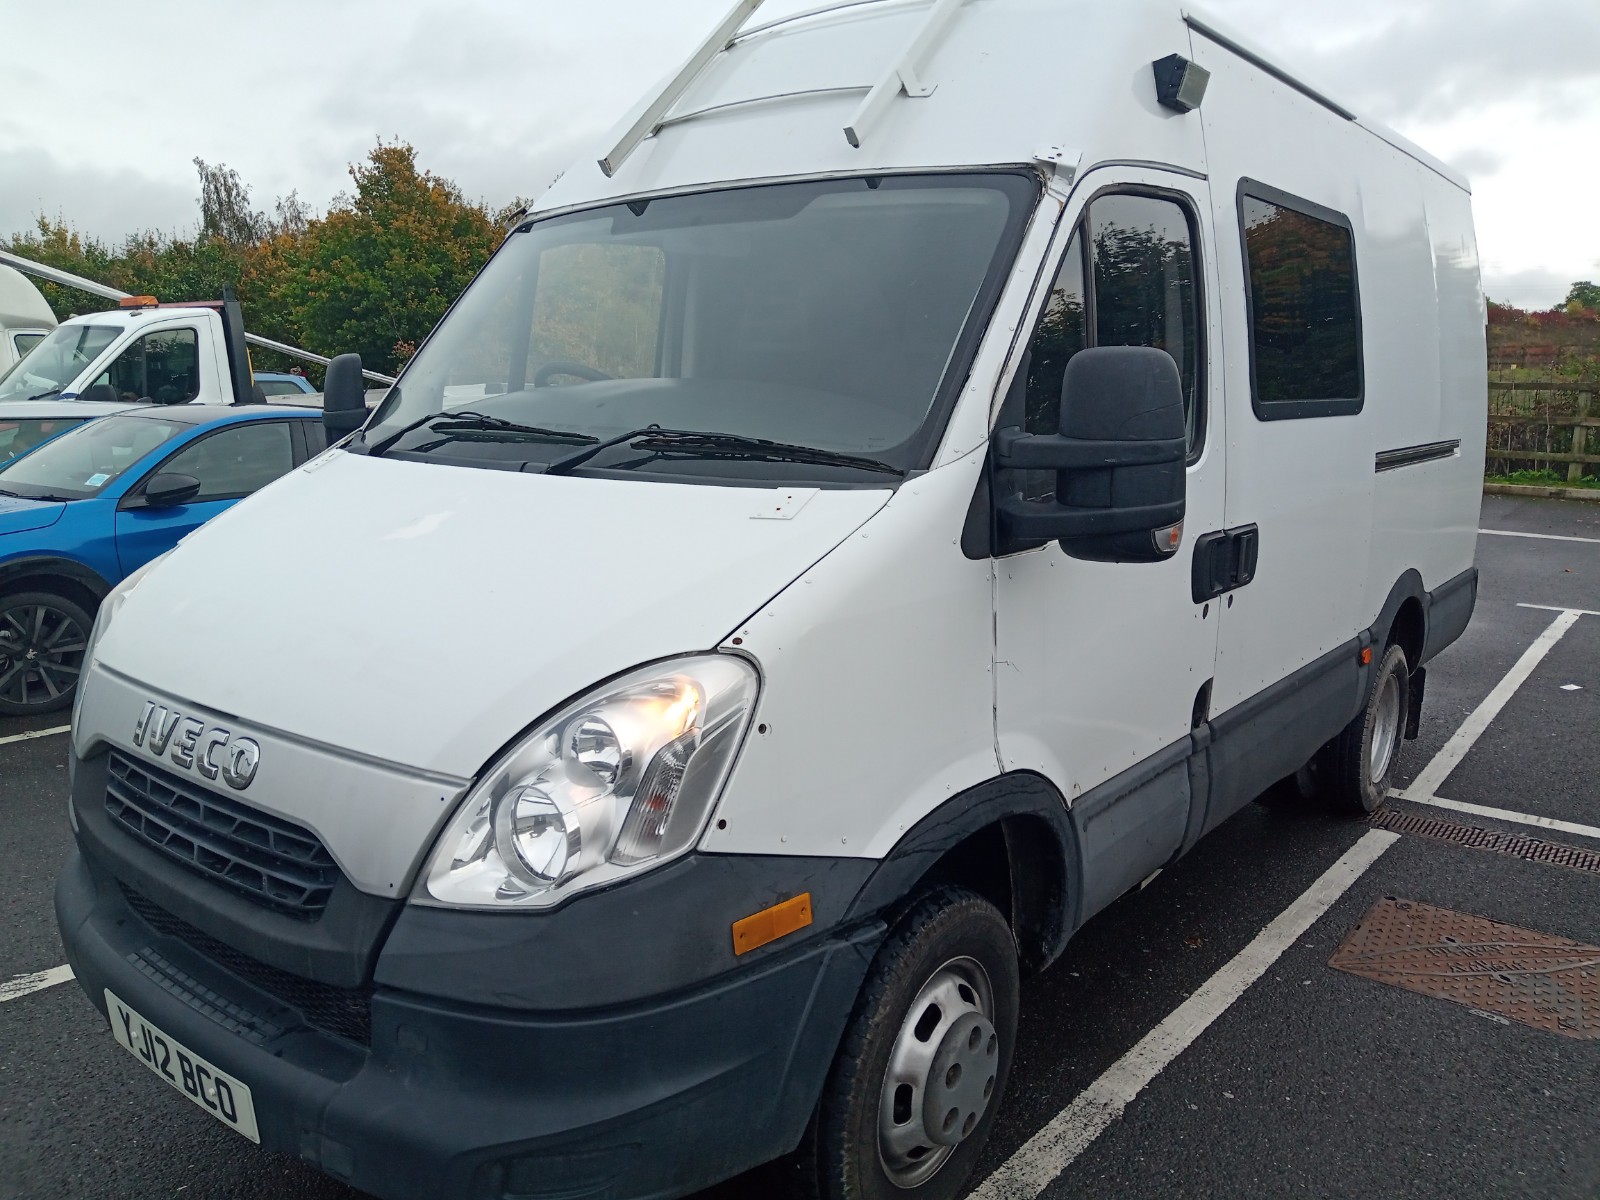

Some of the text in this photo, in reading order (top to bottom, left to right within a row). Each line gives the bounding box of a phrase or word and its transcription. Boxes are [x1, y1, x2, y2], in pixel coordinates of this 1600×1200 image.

[133, 701, 260, 790] IVECO
[117, 1004, 238, 1125] YJ12 BCO
